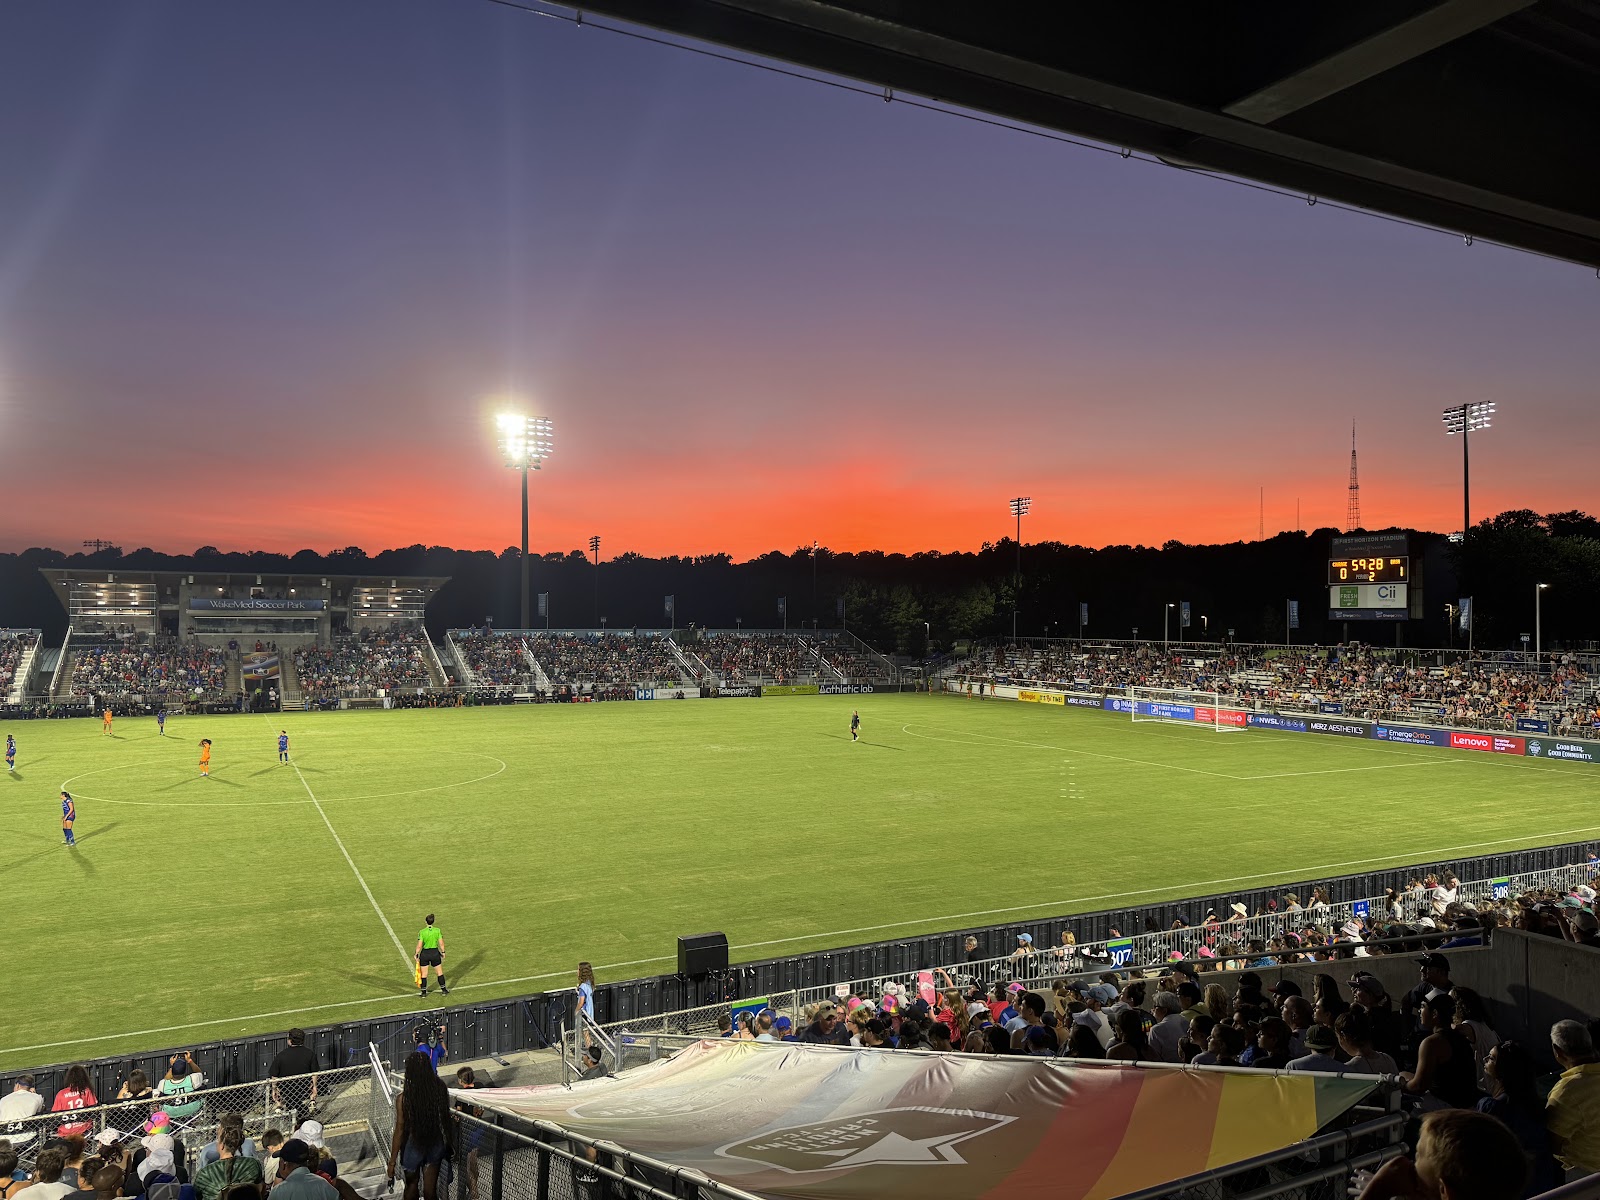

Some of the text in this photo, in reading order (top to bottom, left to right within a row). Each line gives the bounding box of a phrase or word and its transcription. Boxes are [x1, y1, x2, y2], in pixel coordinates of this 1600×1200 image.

[1340, 568, 1347, 579] 0
[1369, 572, 1375, 581] 2
[1378, 586, 1396, 598] Cii
[209, 600, 306, 609] WakeMed Soccer Park
[636, 689, 654, 700] CEI
[826, 685, 874, 693] athletic lab
[1079, 698, 1101, 707] AESTHETICS
[1310, 722, 1364, 735] MERZ AESTHETICS
[1389, 729, 1431, 740] EmergeOrtho
[1453, 735, 1488, 747] Lenovo
[1556, 743, 1570, 751] GOOD
[1548, 749, 1592, 760] GOOD COMMUNITY.
[1493, 886, 1509, 901] 308
[1109, 949, 1132, 969] 307
[7, 1120, 24, 1132] 54
[747, 1118, 879, 1151] CAROLINA
[788, 1129, 879, 1151] NORTH
